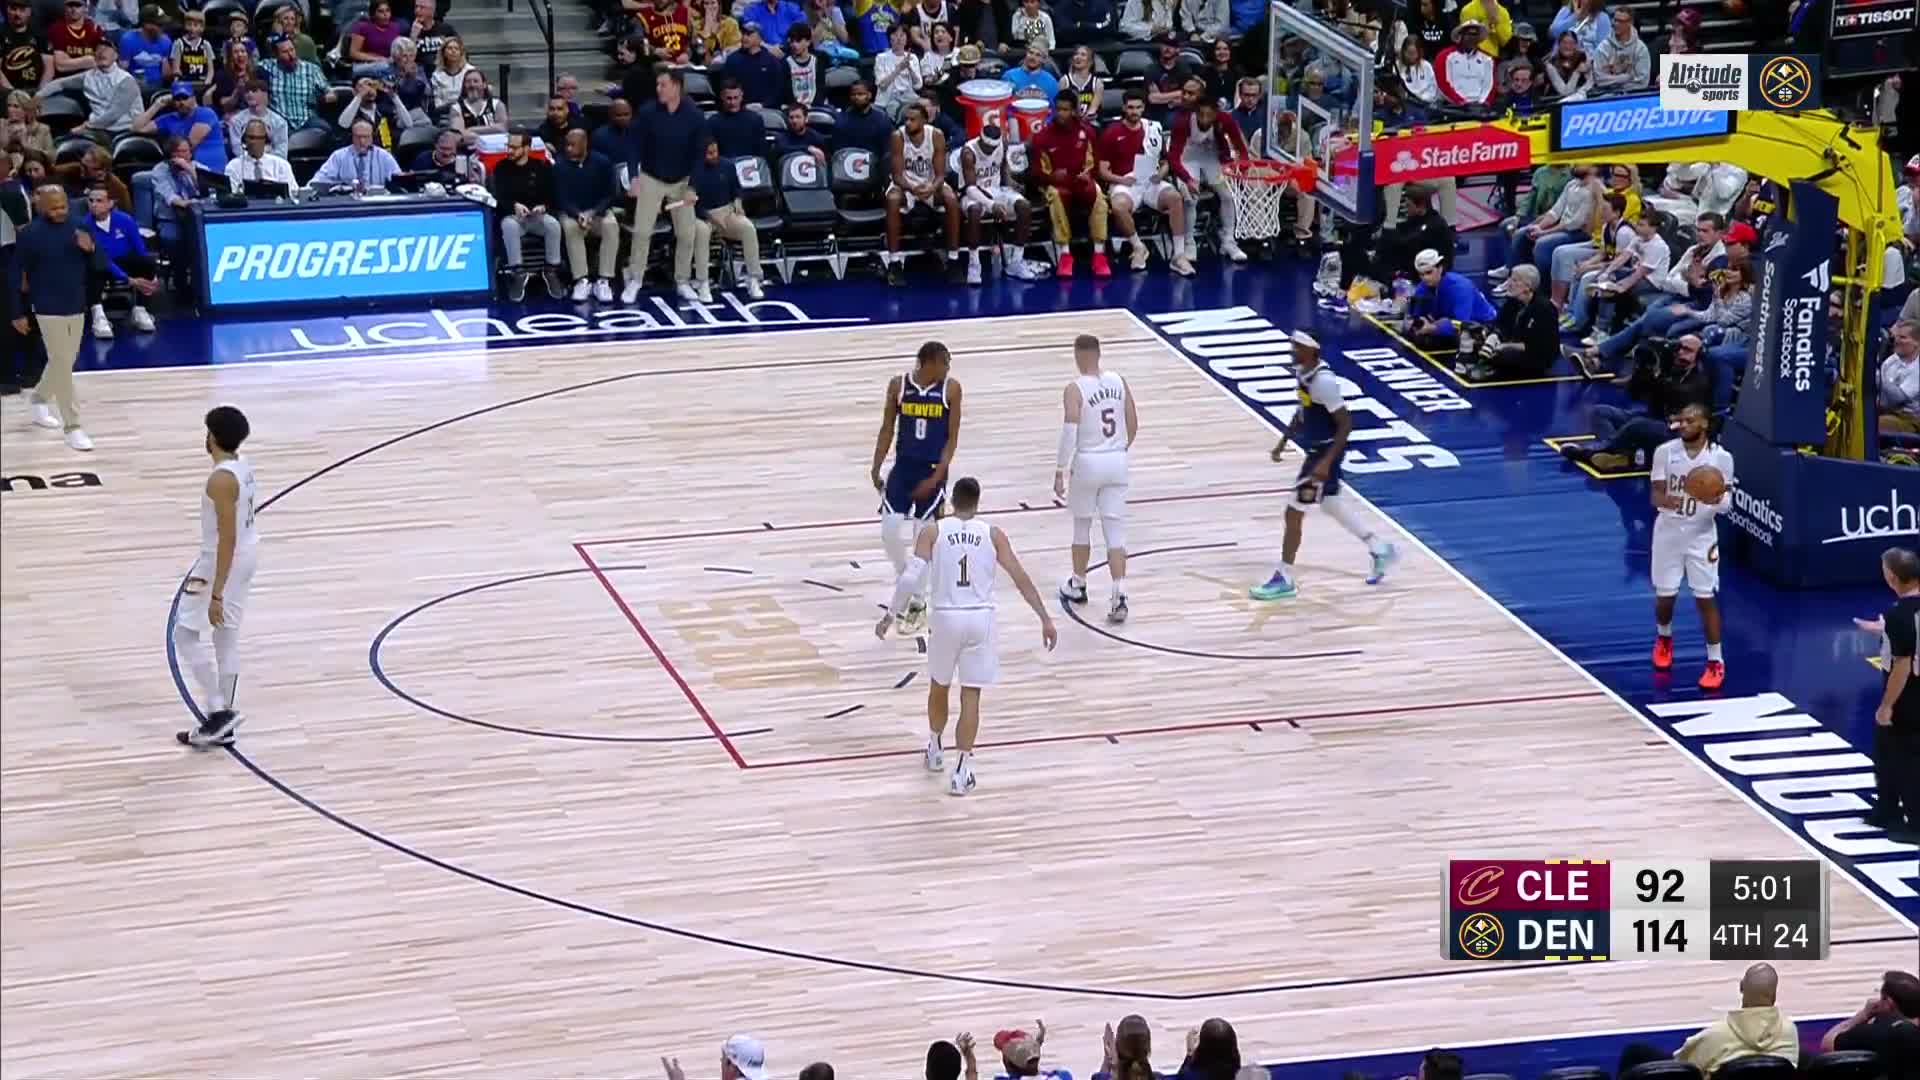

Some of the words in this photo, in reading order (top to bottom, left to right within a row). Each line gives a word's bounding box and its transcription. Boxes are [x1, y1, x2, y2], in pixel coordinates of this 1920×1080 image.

[1858, 8, 1914, 25] TISSOT
[736, 158, 760, 188] G
[790, 155, 817, 184] G
[843, 152, 870, 180] G
[213, 233, 475, 282] PROGRESSIVE
[290, 292, 811, 351] uchealth
[1755, 260, 1775, 375] Southwest
[1780, 298, 1798, 378] Sportsbook
[1795, 297, 1821, 391] Fanatics
[1343, 347, 1473, 412] DENVER
[901, 402, 943, 417] DENVER
[1088, 388, 1122, 407] MERRILL
[1101, 407, 1117, 438] 5
[1677, 497, 1697, 517] 10
[1841, 488, 1920, 537] uch
[947, 532, 982, 547] STRUS
[1728, 508, 1773, 547] Sportsbook
[956, 554, 970, 587] 1
